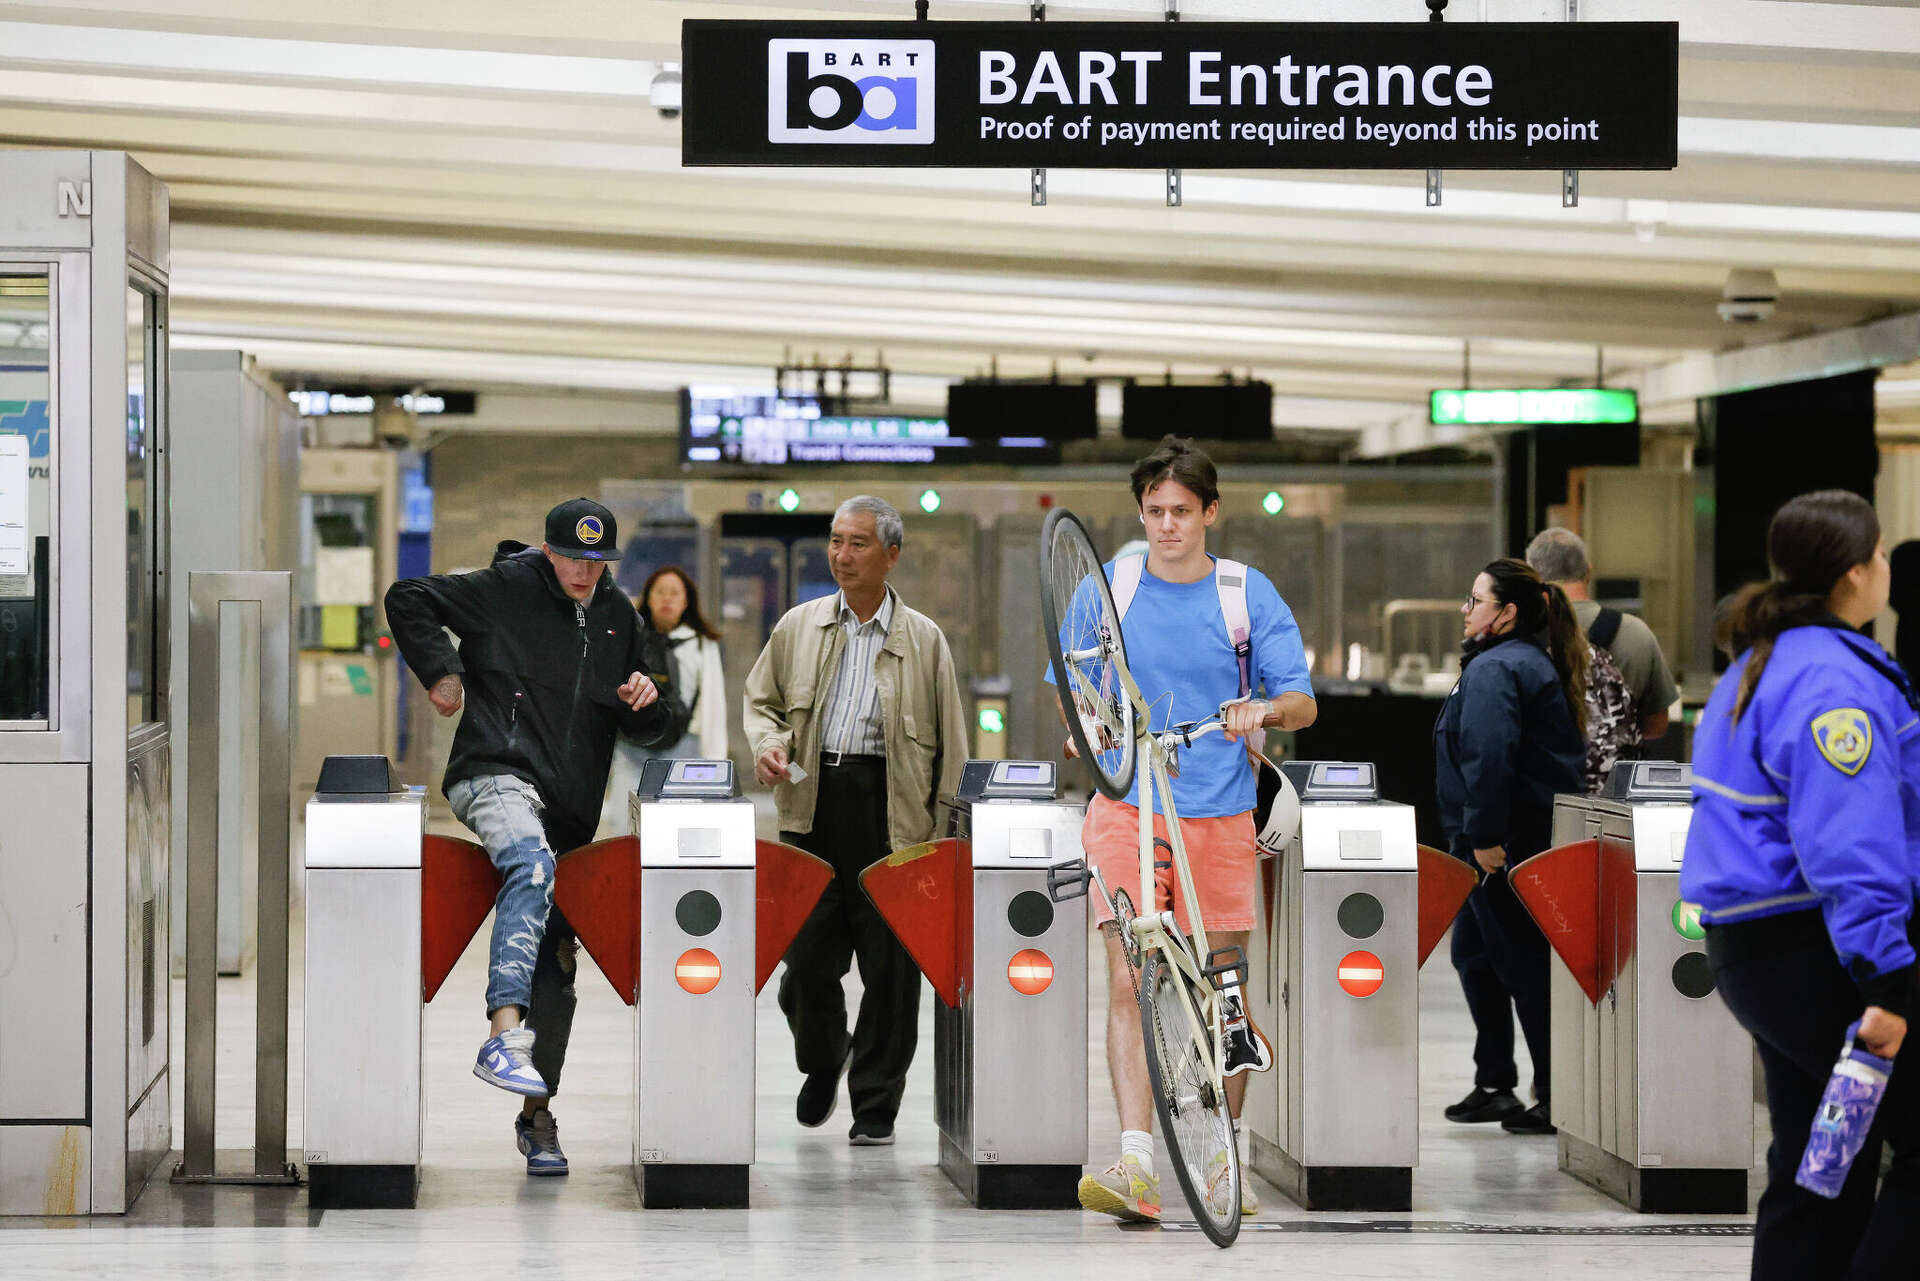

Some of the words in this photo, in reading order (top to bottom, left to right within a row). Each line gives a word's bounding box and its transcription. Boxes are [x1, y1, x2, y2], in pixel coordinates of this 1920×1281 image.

[825, 53, 919, 66] BART
[980, 51, 1162, 104] BART
[1189, 52, 1493, 106] Entrance
[980, 115, 1054, 139] Proof
[1063, 116, 1092, 139] of
[1101, 119, 1221, 146] payment
[1230, 117, 1345, 146] required
[1355, 117, 1457, 146] beyond
[1467, 117, 1517, 140] this
[1527, 117, 1599, 146] point
[58, 182, 91, 215] N
